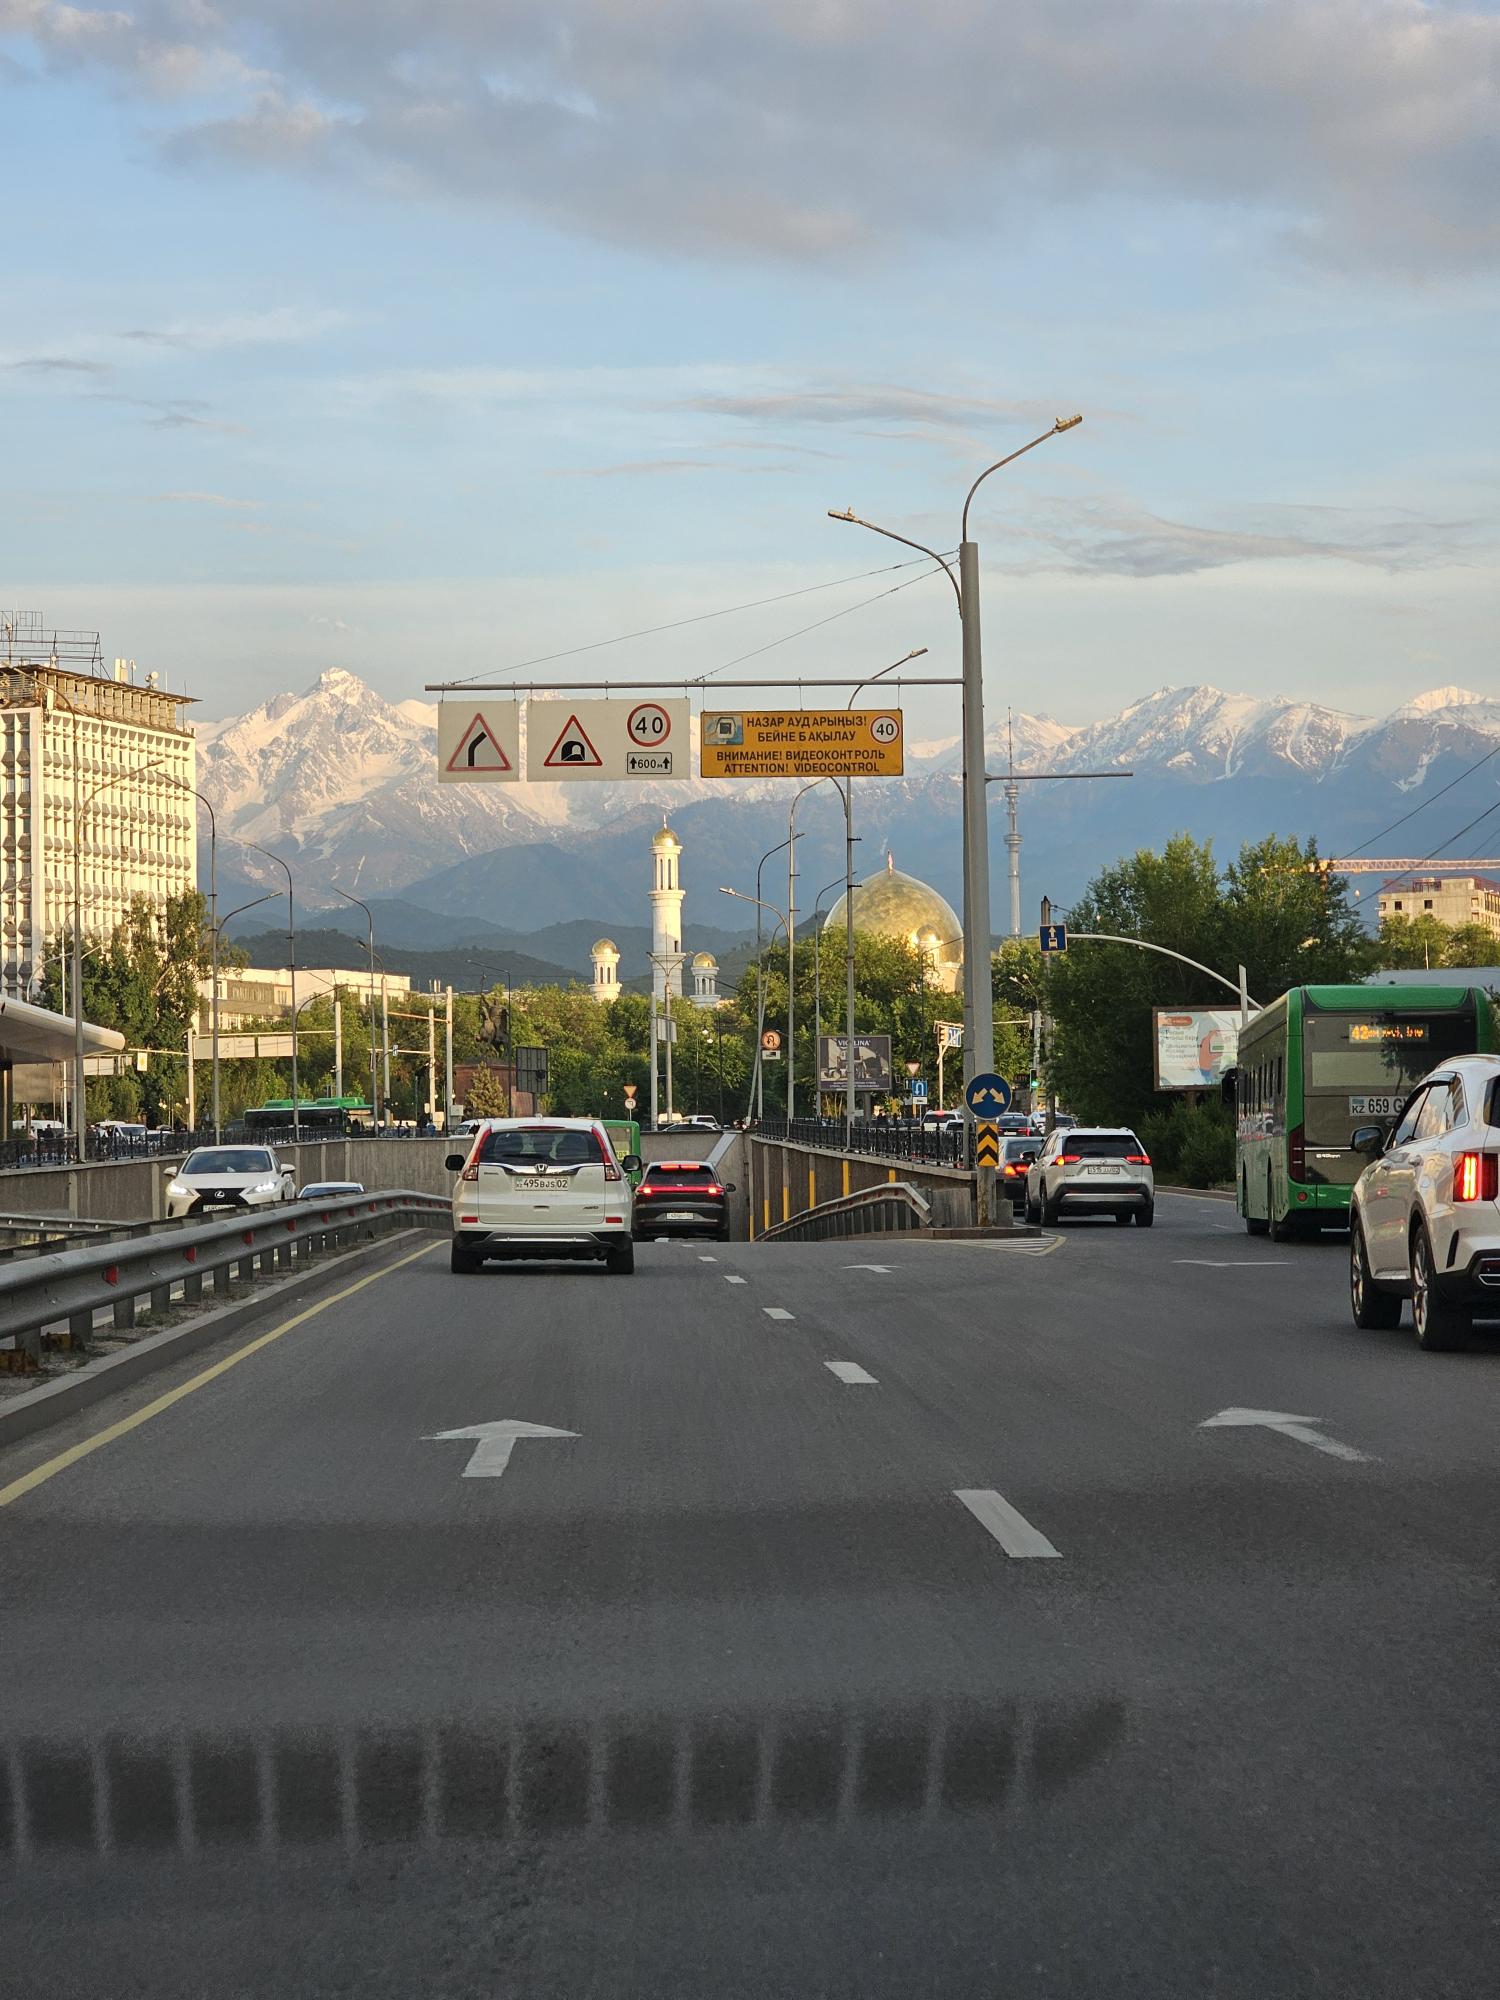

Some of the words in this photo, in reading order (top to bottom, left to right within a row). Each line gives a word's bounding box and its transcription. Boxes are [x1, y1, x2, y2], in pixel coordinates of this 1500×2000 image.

[634, 716, 664, 734] 40
[747, 716, 784, 727] НАЗАР
[787, 715, 867, 728] АУДАРЫҢЫЗ!
[758, 730, 796, 742] БЕЙНЕ
[798, 731, 856, 743] БАҚЫЛАУ
[876, 724, 894, 736] 40
[716, 750, 782, 761] ВНИМАНИЕ!
[785, 749, 885, 761] ВИДЕОКОНТРОЛЬ
[724, 763, 788, 773] ATTENTION!
[794, 762, 880, 773] VIDEOCONTROL
[1352, 1105, 1365, 1114] KZ
[1368, 1098, 1390, 1114] 659
[1393, 1098, 1408, 1114] G
